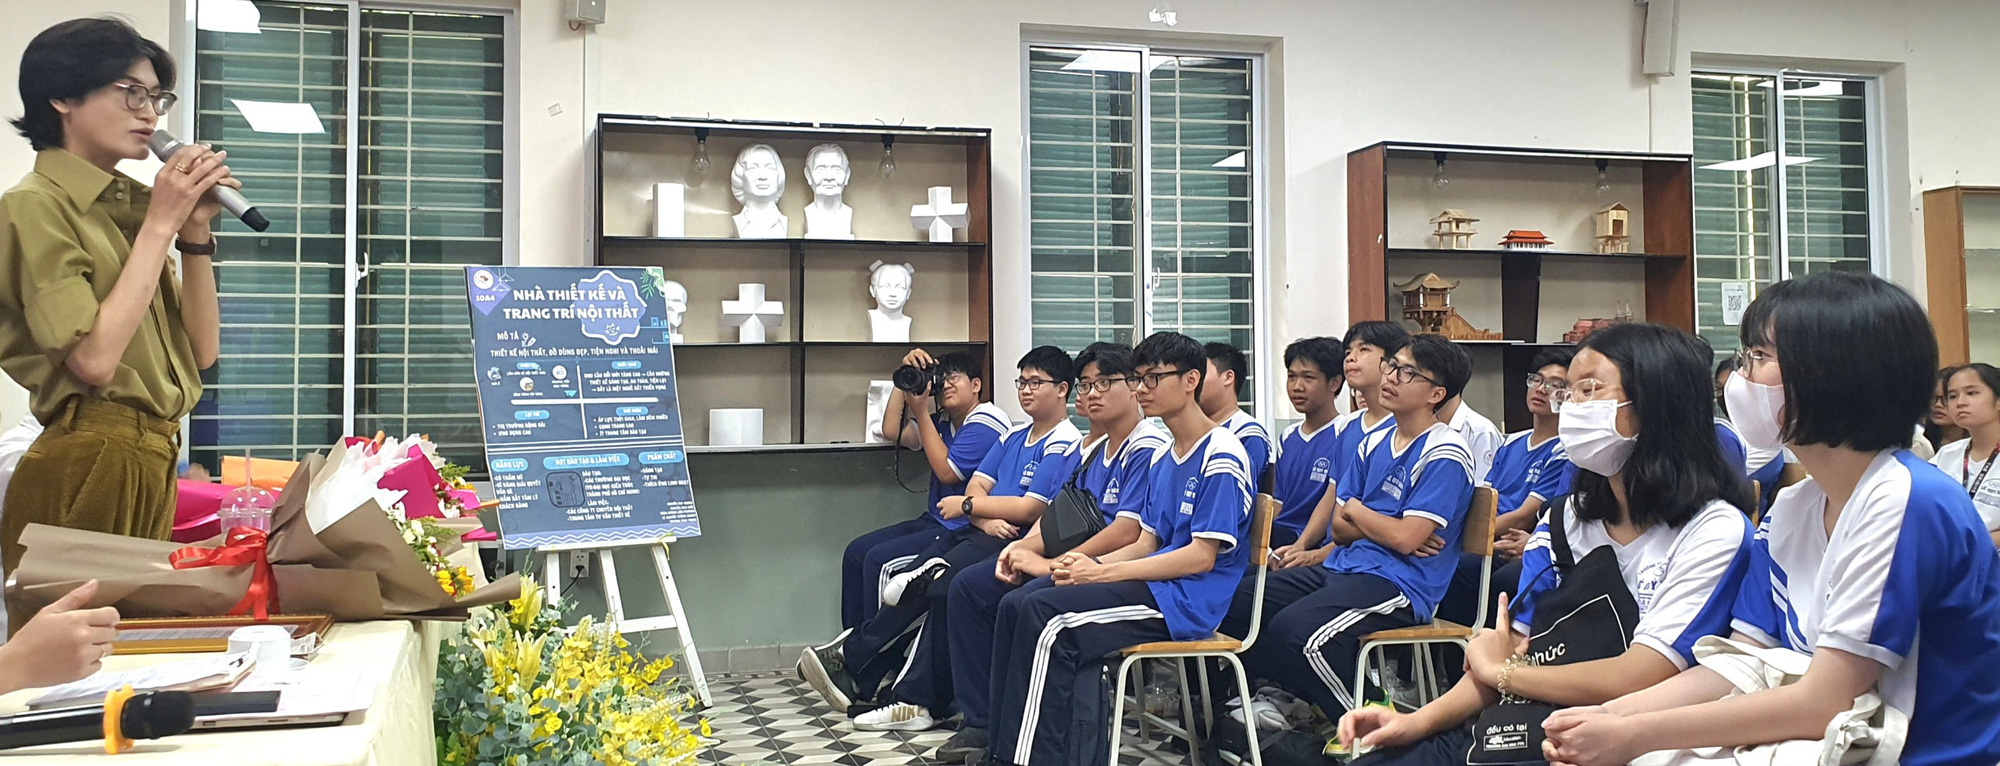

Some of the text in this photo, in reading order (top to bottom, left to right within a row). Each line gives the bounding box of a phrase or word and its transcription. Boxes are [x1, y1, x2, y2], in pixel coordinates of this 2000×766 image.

[513, 283, 627, 301] NHÀ THIẾT KẾ VÀ
[503, 301, 639, 322] TRANG TRÍ NỘI THẤT
[497, 330, 508, 340] MÔ
[490, 348, 508, 357] THIẾT
[509, 348, 517, 356] KẾ
[519, 348, 529, 358] NỘI
[531, 347, 548, 357] THẤT,
[549, 347, 557, 356] ĐỒ
[559, 347, 575, 355] DÙNG
[590, 347, 603, 356] TIỆN
[620, 346, 628, 354] VÀ
[647, 346, 658, 354] MÁI
[496, 460, 512, 468] NĂNG
[608, 454, 620, 463] VIỆC
[1531, 643, 1565, 666] hức
[1503, 723, 1514, 732] có
[1516, 723, 1527, 732] tại
